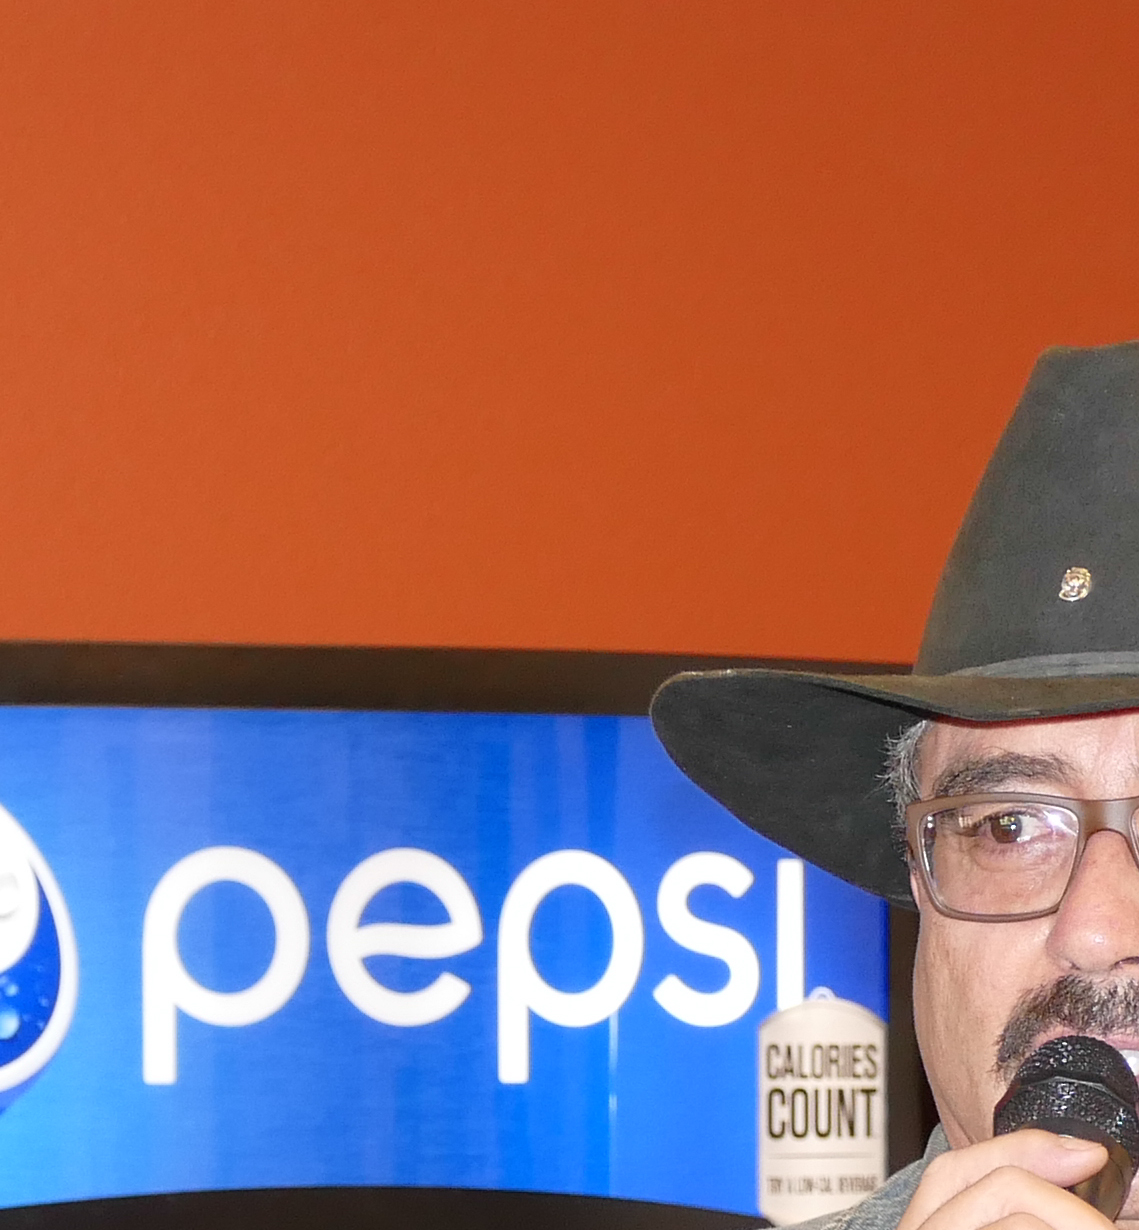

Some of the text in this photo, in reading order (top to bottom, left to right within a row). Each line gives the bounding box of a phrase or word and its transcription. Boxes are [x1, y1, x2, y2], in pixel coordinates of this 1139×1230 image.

[142, 846, 805, 1085] pepsi
[767, 1044, 878, 1079] CALORIES
[768, 1088, 877, 1138] COUNT
